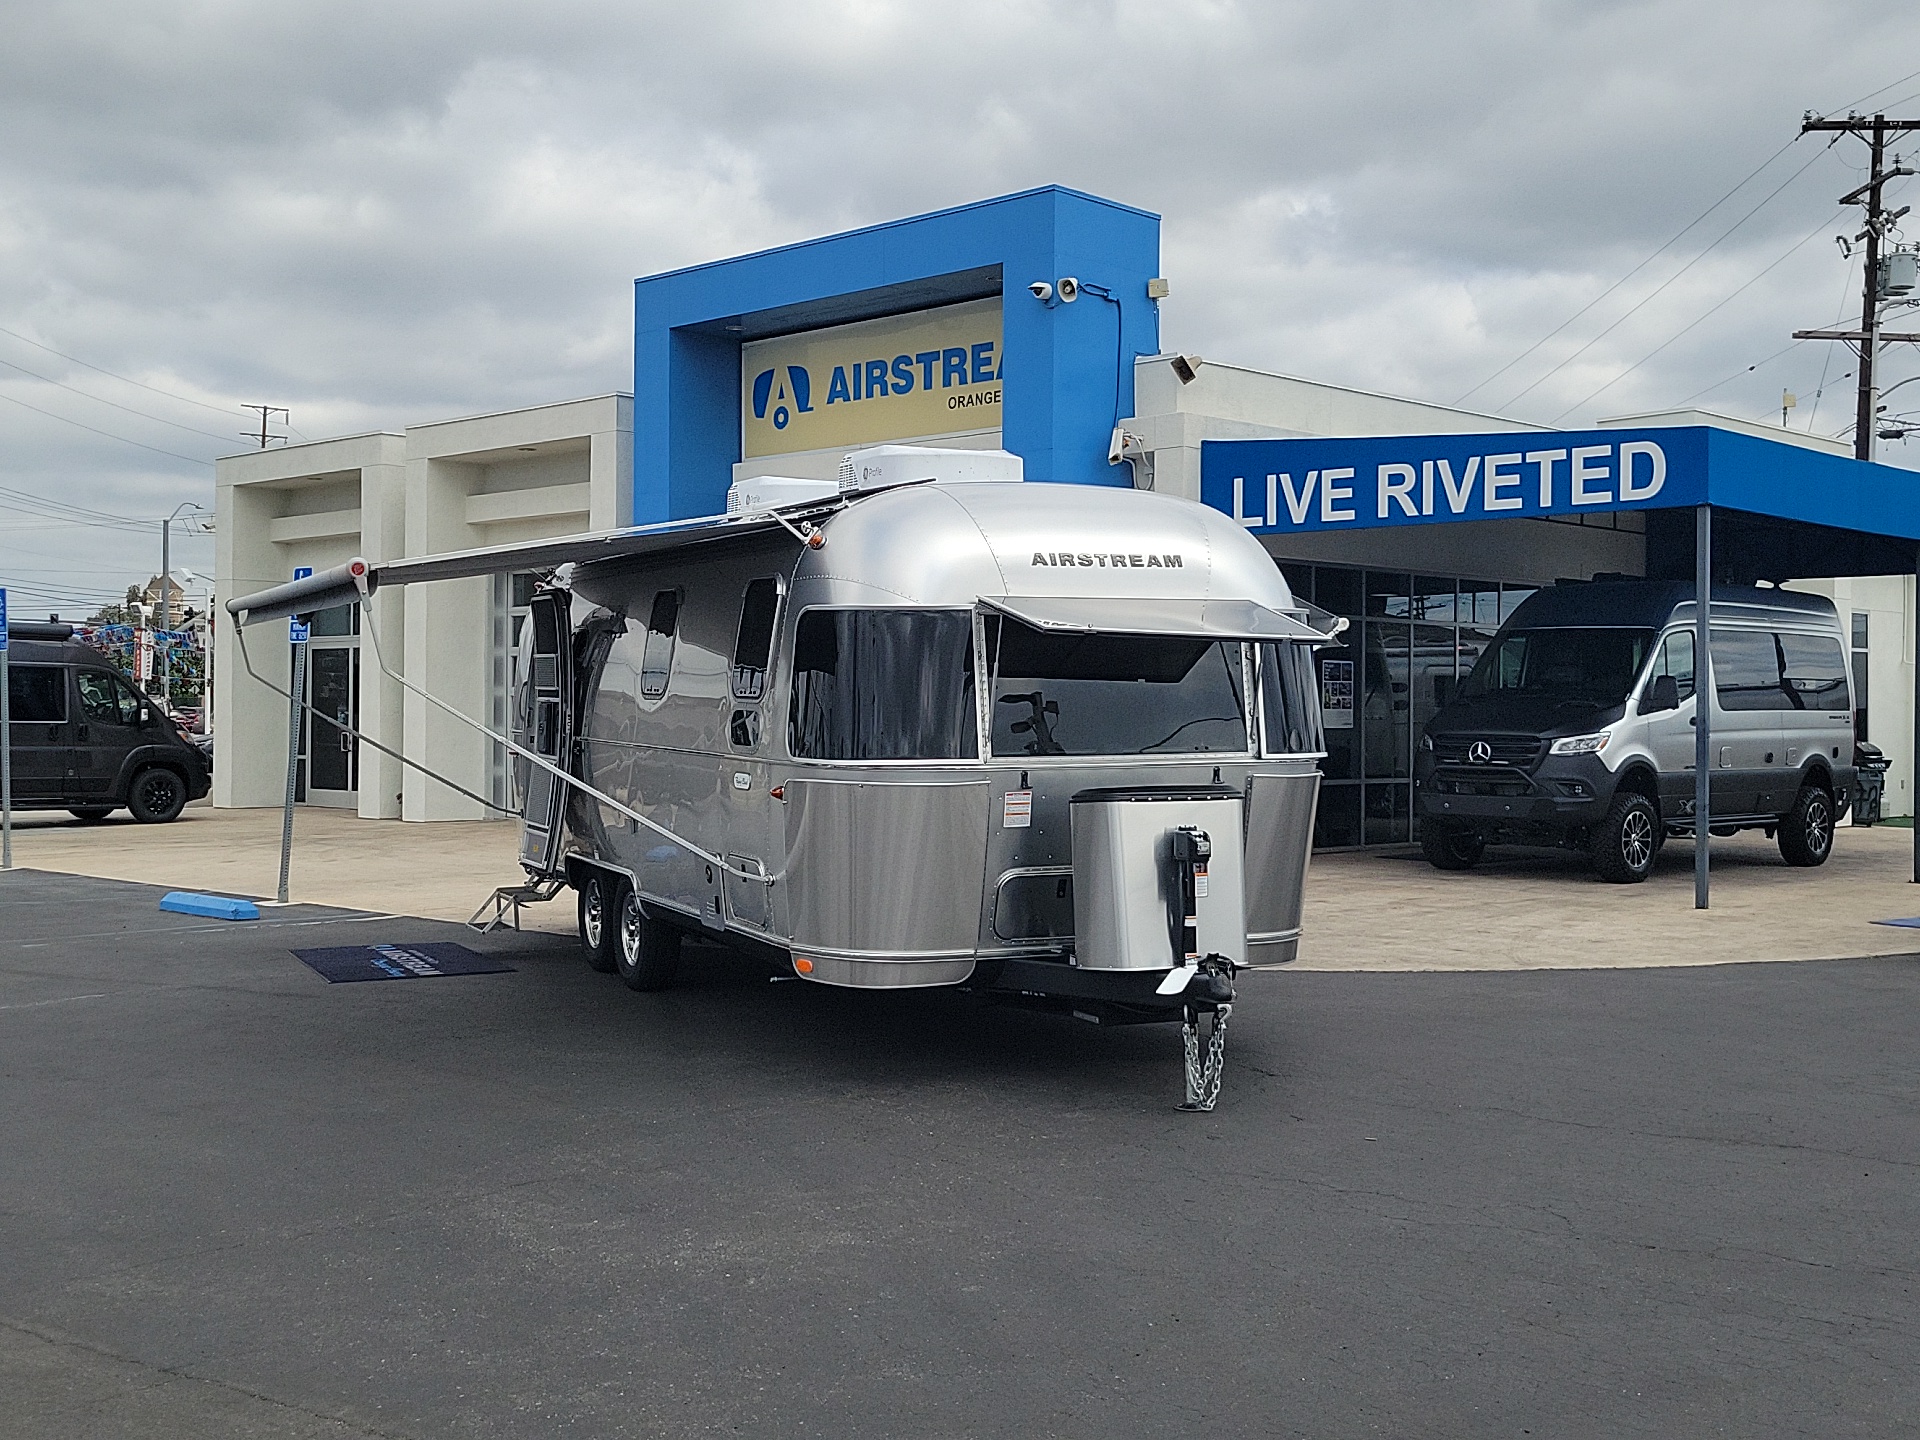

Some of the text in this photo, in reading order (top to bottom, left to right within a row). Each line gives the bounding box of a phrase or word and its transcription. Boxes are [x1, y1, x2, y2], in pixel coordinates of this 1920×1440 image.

[826, 341, 1003, 405] AIRSTRE
[948, 389, 1002, 410] ORANGE
[1233, 440, 1667, 528] LIVE RIVETED
[1031, 552, 1183, 568] AIRSTREAM
